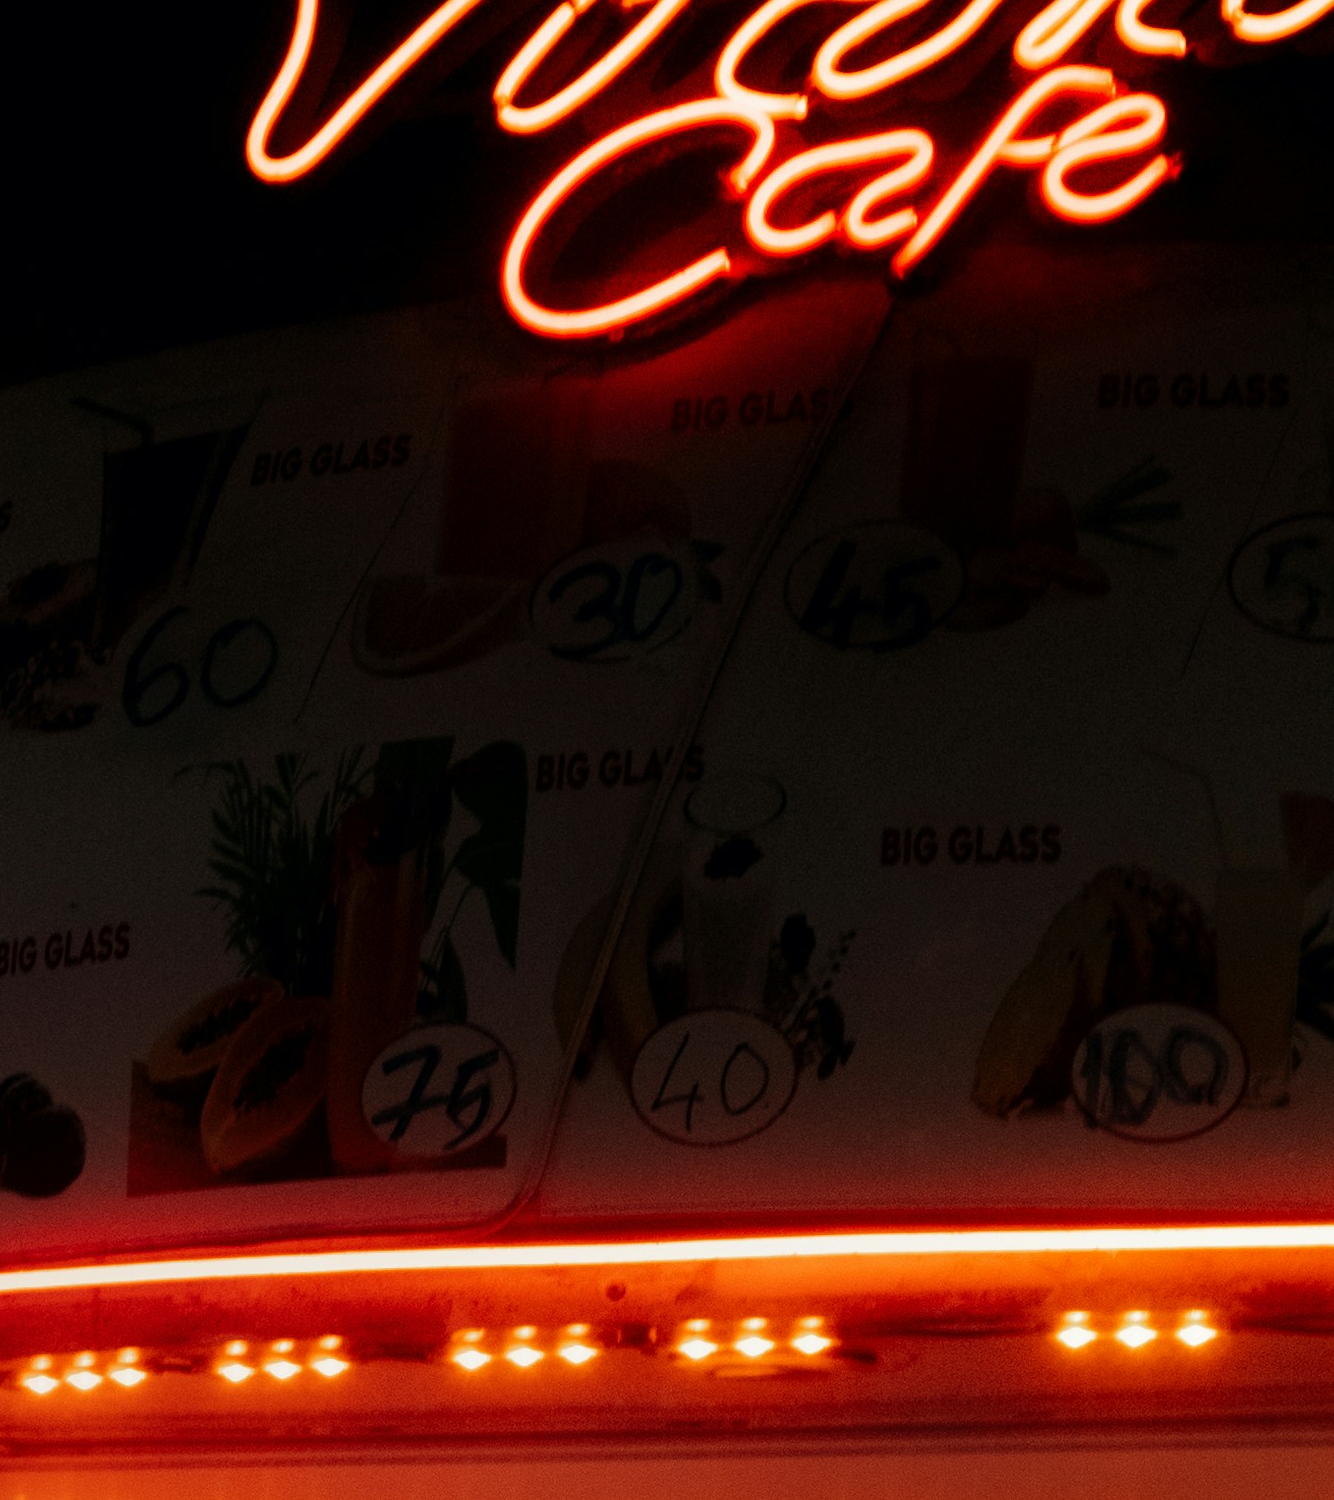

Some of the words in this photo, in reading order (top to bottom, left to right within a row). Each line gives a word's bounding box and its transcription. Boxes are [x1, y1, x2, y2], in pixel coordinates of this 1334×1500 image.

[502, 64, 1175, 335] Cafe
[670, 393, 729, 433] BIG
[1097, 374, 1162, 410] BIG
[1169, 372, 1291, 410] GLASS
[250, 447, 302, 487] BIG
[309, 433, 412, 476] GLASS
[547, 552, 684, 662] 30
[799, 541, 942, 653] 45
[121, 605, 279, 728] 60
[535, 750, 591, 793] BIG
[879, 827, 939, 867] BIG
[947, 824, 1062, 866] GLASS
[43, 920, 132, 971] GLASS
[371, 1044, 501, 1151] 75
[651, 1033, 770, 1133] 40
